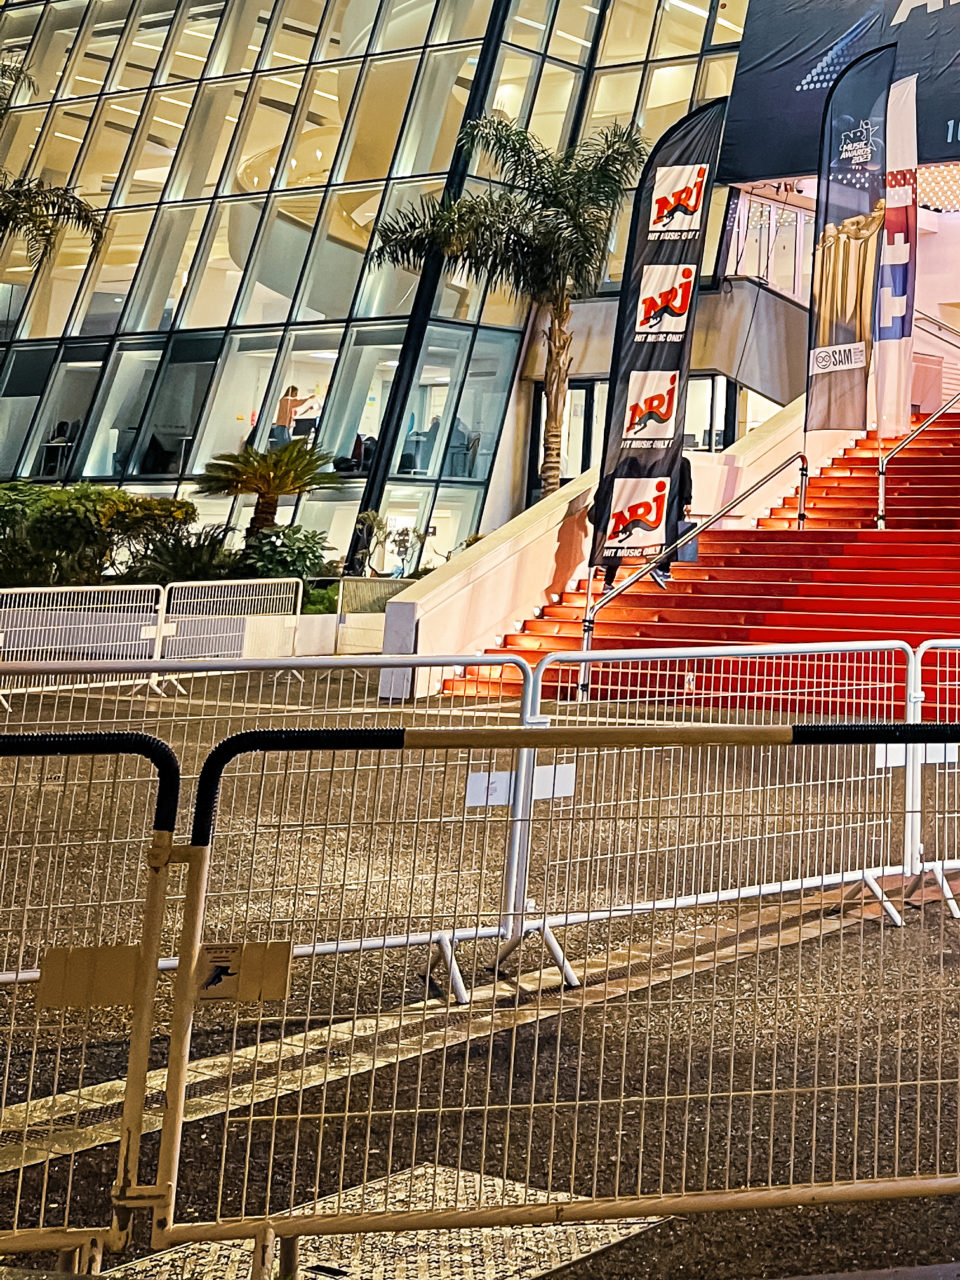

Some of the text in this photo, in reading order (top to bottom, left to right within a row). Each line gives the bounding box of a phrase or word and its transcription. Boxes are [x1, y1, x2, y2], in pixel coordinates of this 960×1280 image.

[843, 141, 868, 152] MUSIC
[840, 148, 871, 159] AWARDS
[832, 348, 853, 367] SAM
[603, 548, 617, 557] HIT
[616, 547, 642, 557] MUSIC
[642, 545, 661, 555] ONLY
